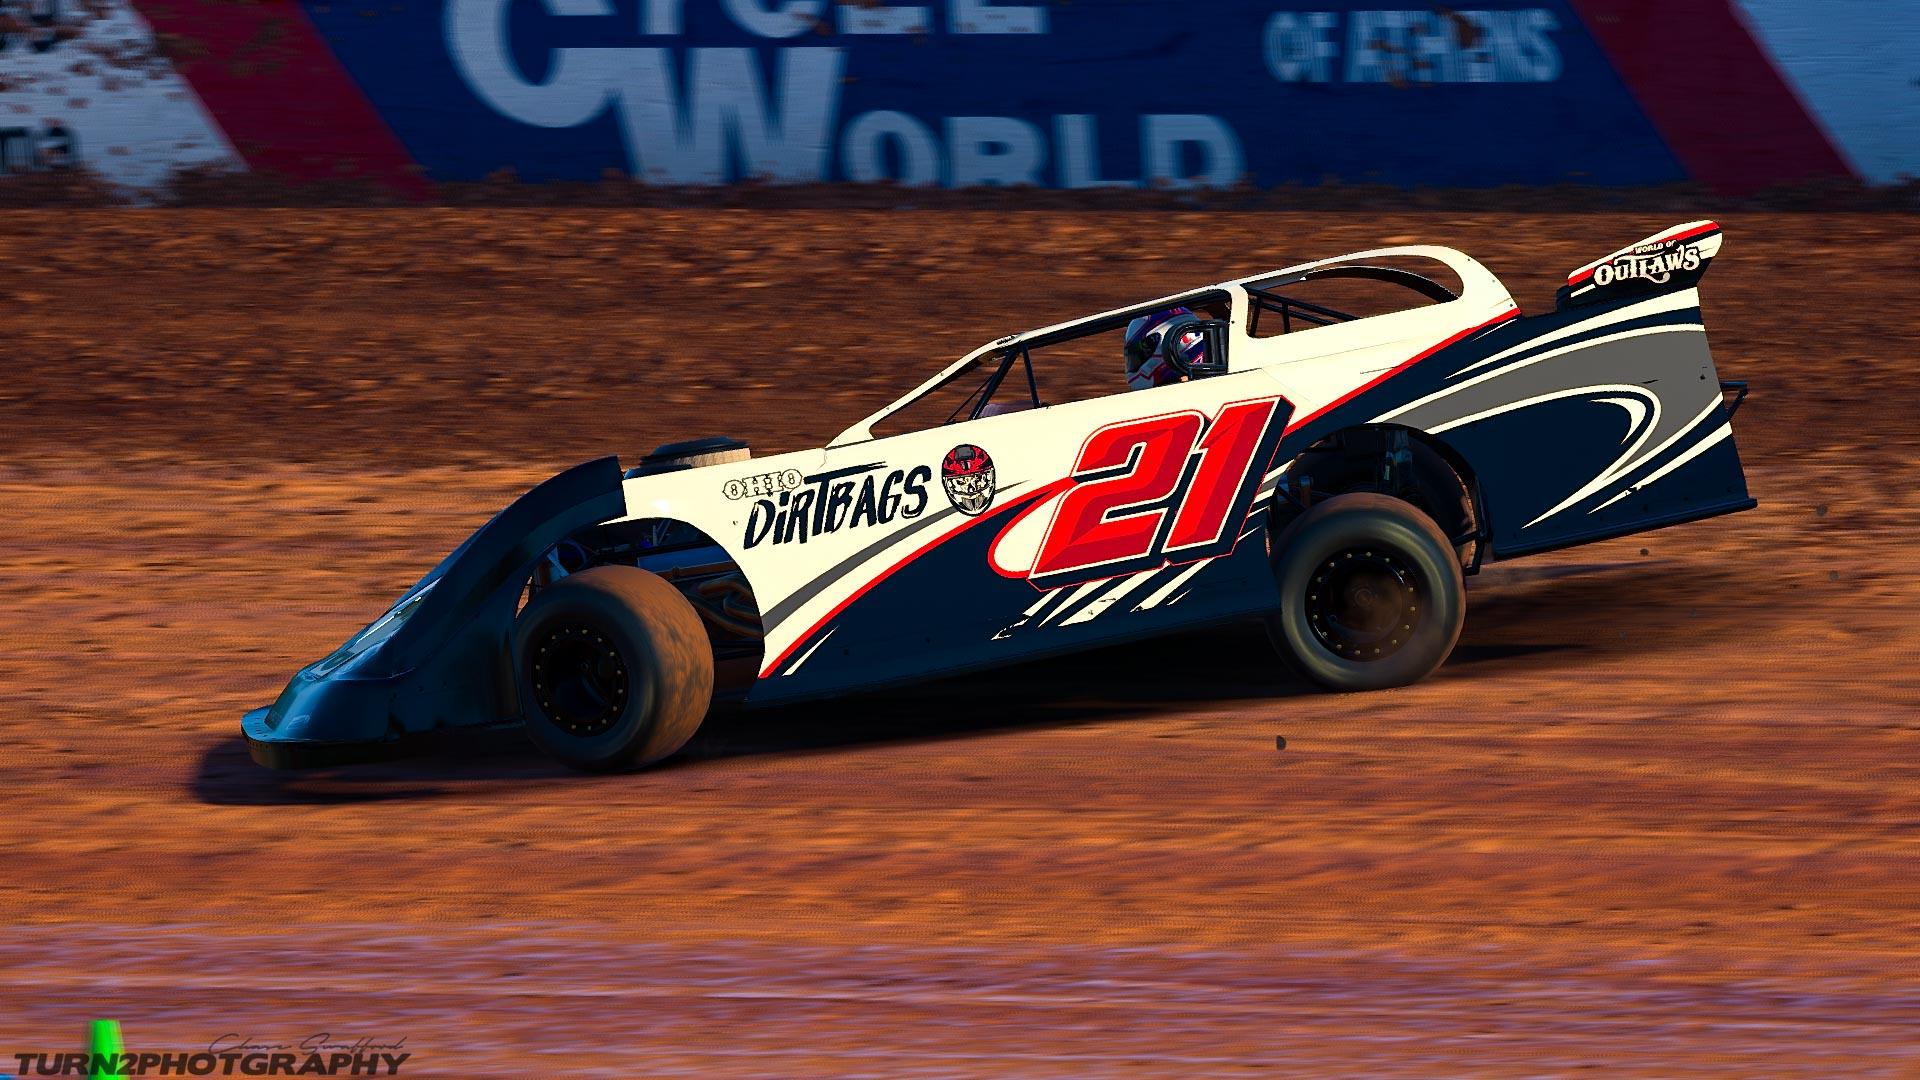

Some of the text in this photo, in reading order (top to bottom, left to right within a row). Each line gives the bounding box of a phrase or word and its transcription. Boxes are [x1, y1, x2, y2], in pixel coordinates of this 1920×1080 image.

[612, 47, 1246, 190] WORLD
[1634, 242, 1664, 254] WORLD
[1026, 394, 1296, 592] 21
